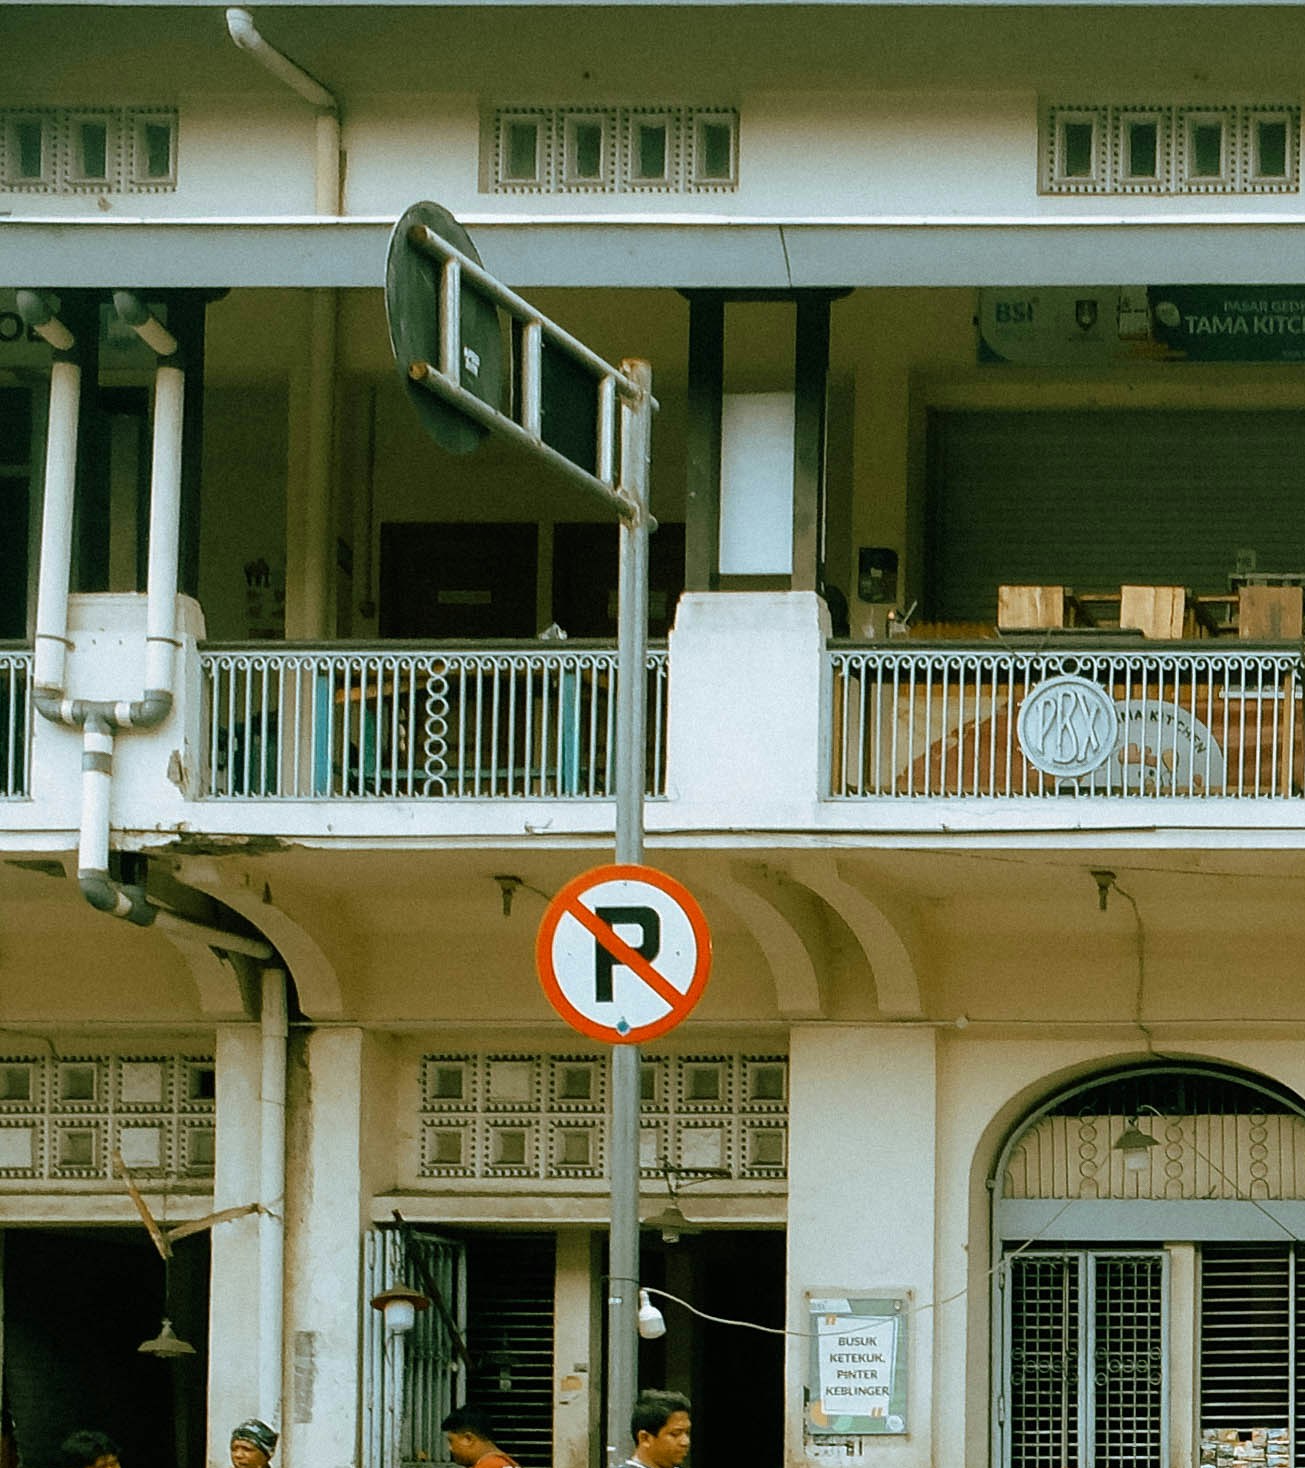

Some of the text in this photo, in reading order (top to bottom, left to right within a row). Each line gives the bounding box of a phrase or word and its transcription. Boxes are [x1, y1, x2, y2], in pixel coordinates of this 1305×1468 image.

[1185, 315, 1249, 334] TAMA
[595, 906, 661, 1003] P
[837, 1336, 878, 1347] BUSUK
[836, 1369, 878, 1380] PINTER
[825, 1385, 890, 1397] KEBLINGER
